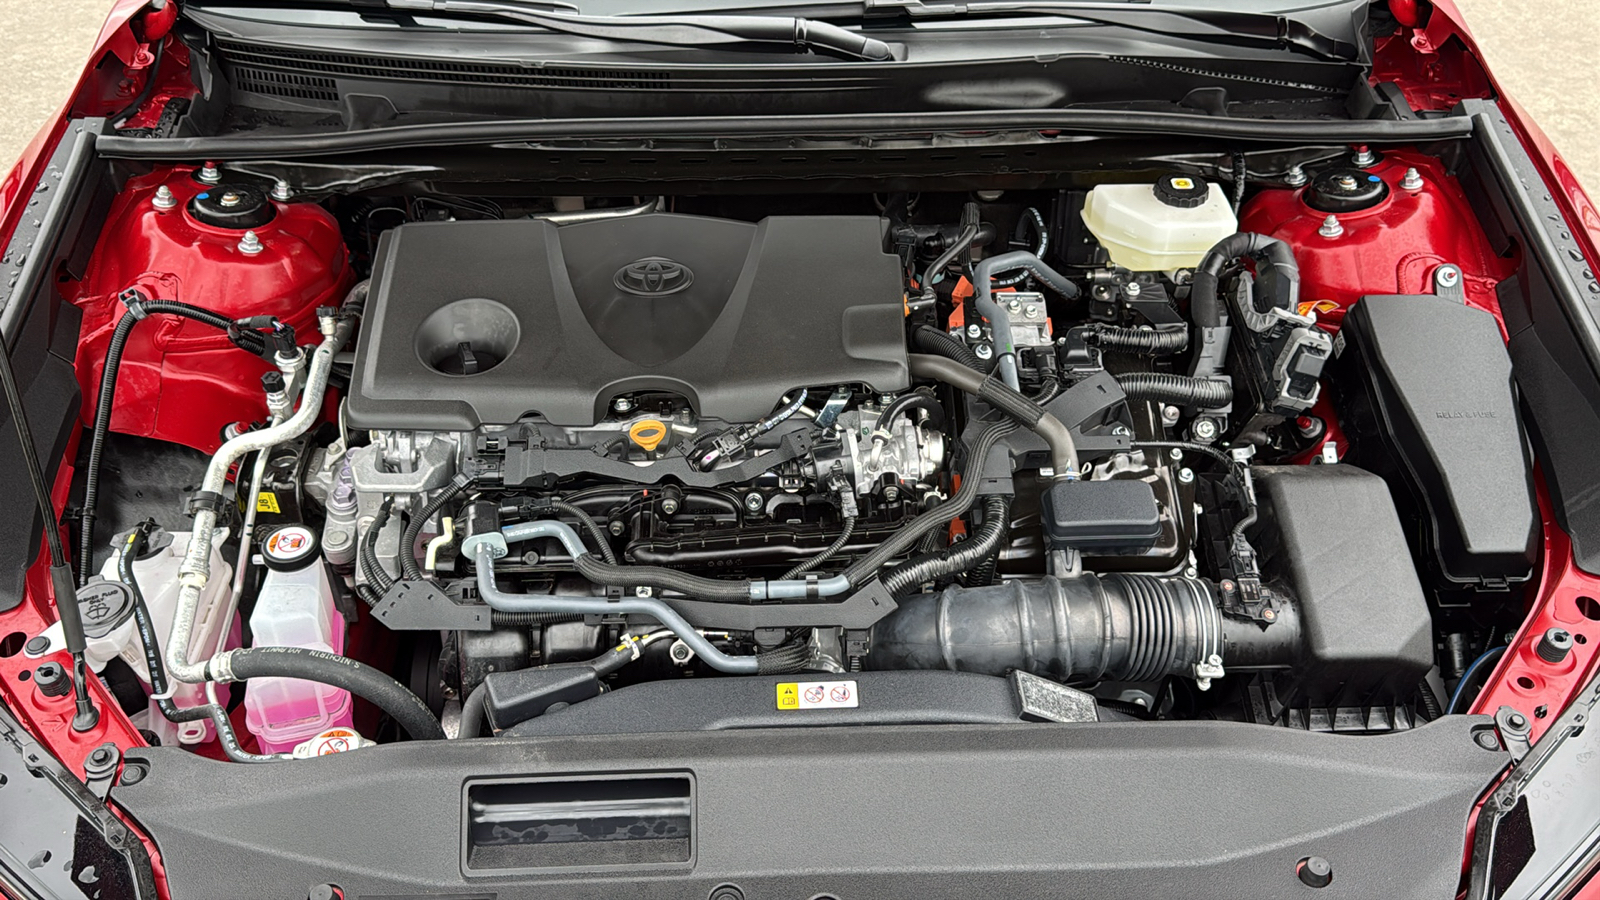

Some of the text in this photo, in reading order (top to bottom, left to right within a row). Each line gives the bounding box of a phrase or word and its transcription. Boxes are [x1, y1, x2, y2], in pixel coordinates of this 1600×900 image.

[1435, 411, 1463, 419] RELAY
[1473, 411, 1497, 419] FUSE
[77, 594, 99, 603] ASHER
[135, 607, 145, 623] WATER
